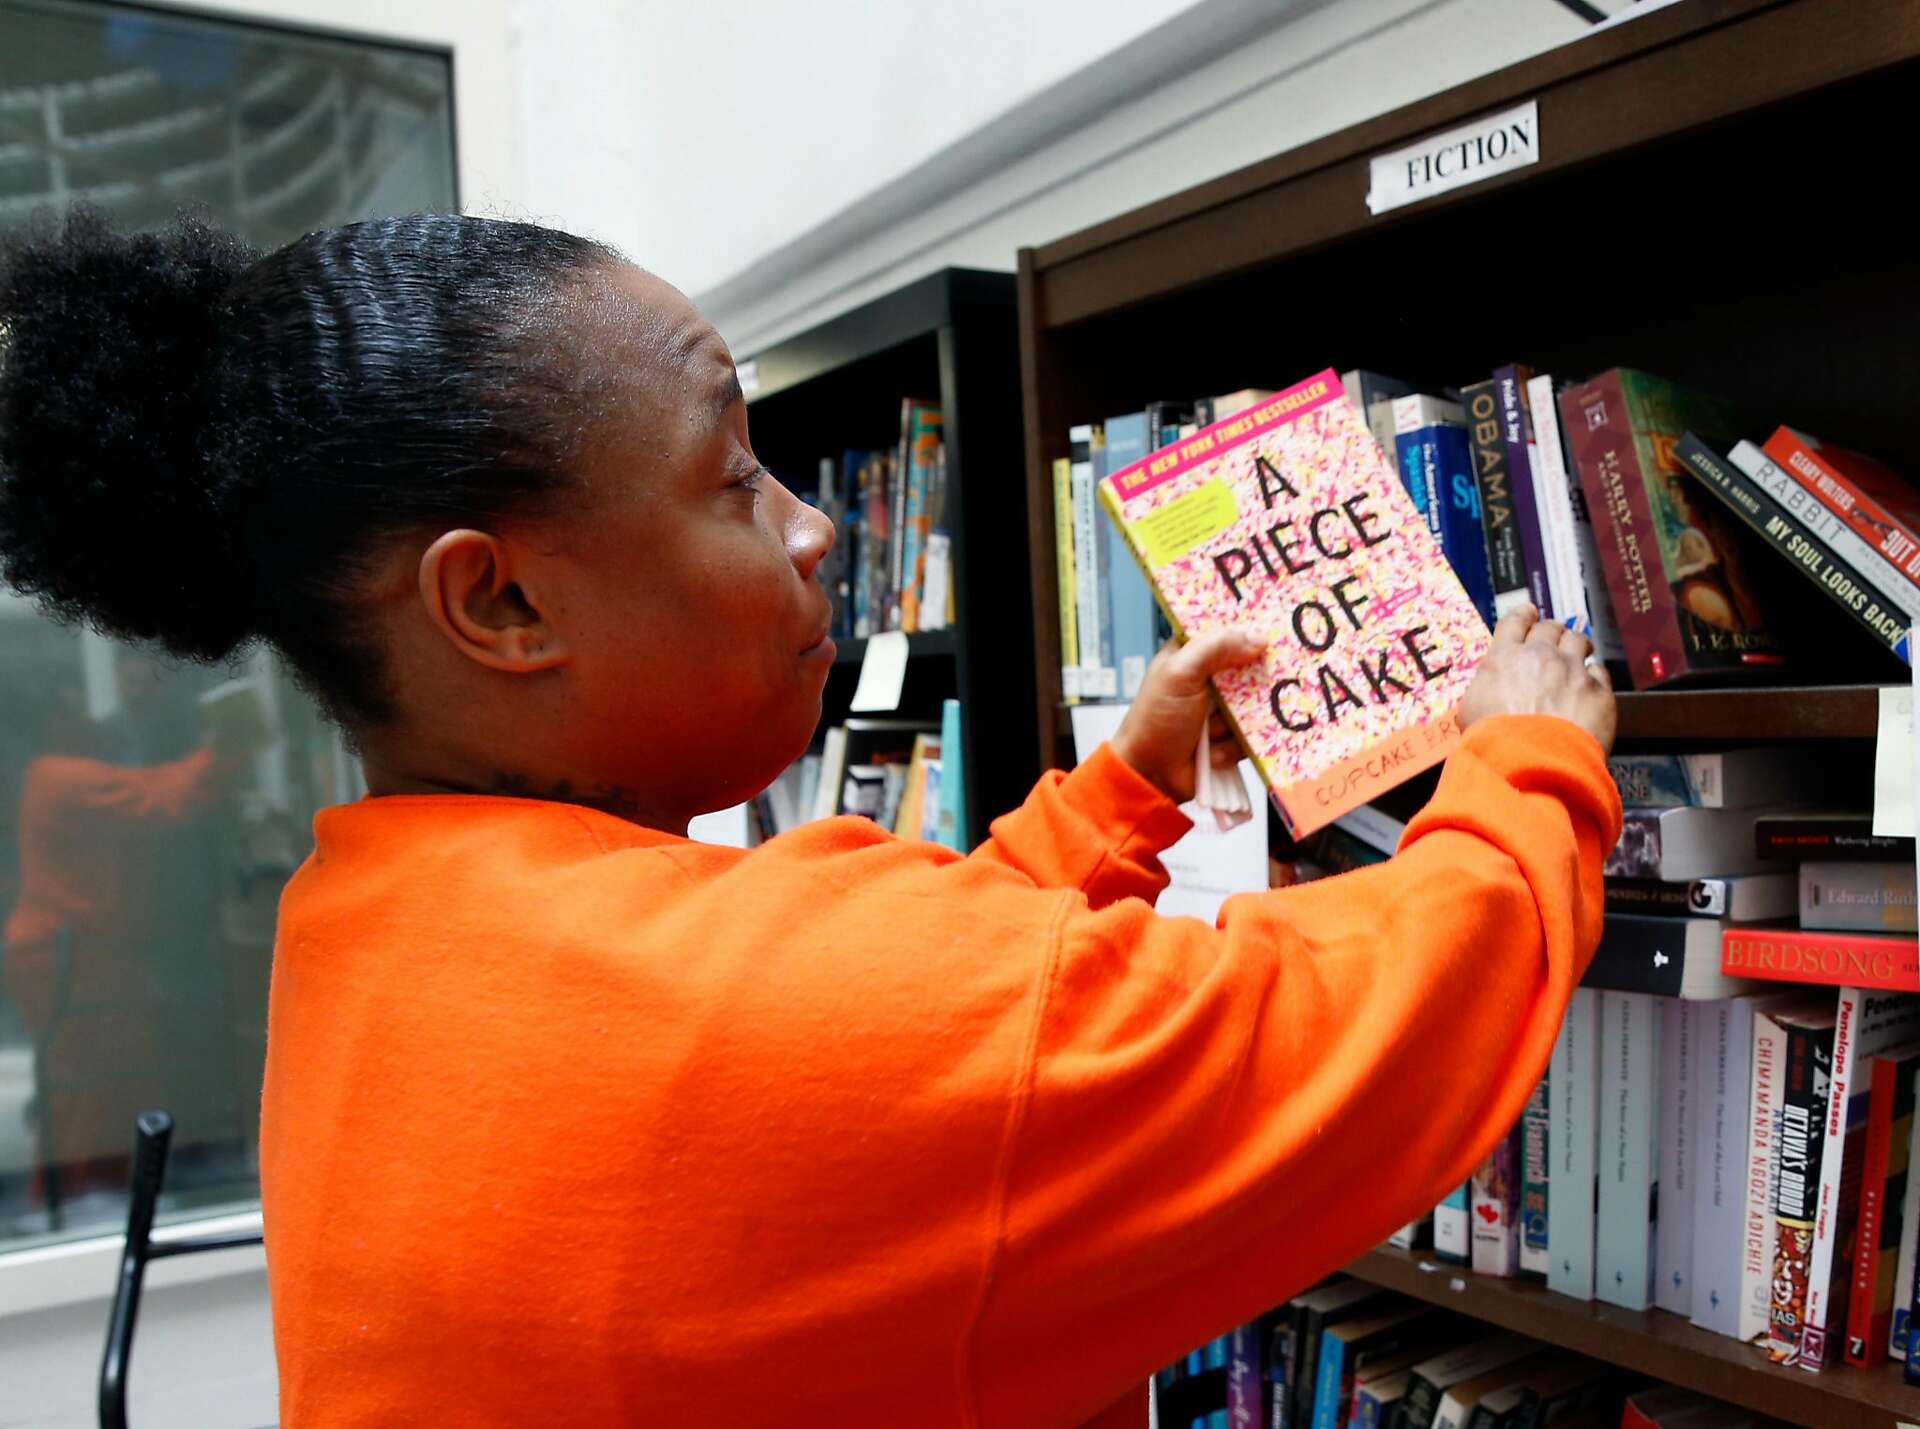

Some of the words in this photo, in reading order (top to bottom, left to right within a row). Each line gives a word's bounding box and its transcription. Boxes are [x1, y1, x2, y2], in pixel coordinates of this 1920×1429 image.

[1406, 119, 1531, 187] FICTION
[1119, 468, 1149, 490] THE
[1149, 450, 1179, 475] NEW
[1180, 435, 1215, 460] YORK
[1216, 416, 1254, 443] TIMES
[1253, 380, 1329, 426] BESTSELLER
[1506, 406, 1517, 423] &
[1507, 421, 1520, 444] Joy
[1255, 456, 1299, 509] A
[1472, 394, 1511, 529] OBAMA
[1788, 451, 1818, 482] CLEARY
[1816, 472, 1857, 512] WOLTERS
[1605, 451, 1633, 525] HARRY
[1626, 533, 1652, 613] POTTER
[1756, 463, 1847, 542] RABBIT
[1212, 492, 1391, 602] PIECE
[1765, 515, 1792, 541] MY
[1787, 535, 1825, 573] SOUL
[1820, 565, 1869, 611] LOOKS
[1863, 602, 1906, 645] BACK
[1880, 528, 1917, 564] OUT
[1291, 575, 1369, 652] OF
[1269, 625, 1452, 733] CAKE
[1314, 738, 1417, 806] CUPCAKE
[1827, 888, 1881, 905] Edward
[1726, 938, 1896, 981] BIRDSONG
[1830, 1000, 1854, 1075] Penelope
[1753, 1037, 1774, 1150] CHIMAMANDA
[1828, 1077, 1847, 1138] Passes
[1781, 1103, 1809, 1172] OCTAVIA'S
[1750, 1156, 1768, 1207] NGOZI
[1778, 1169, 1806, 1217] BROOD
[1746, 1214, 1765, 1276] ADICHIE
[1850, 1336, 1863, 1355] 7
